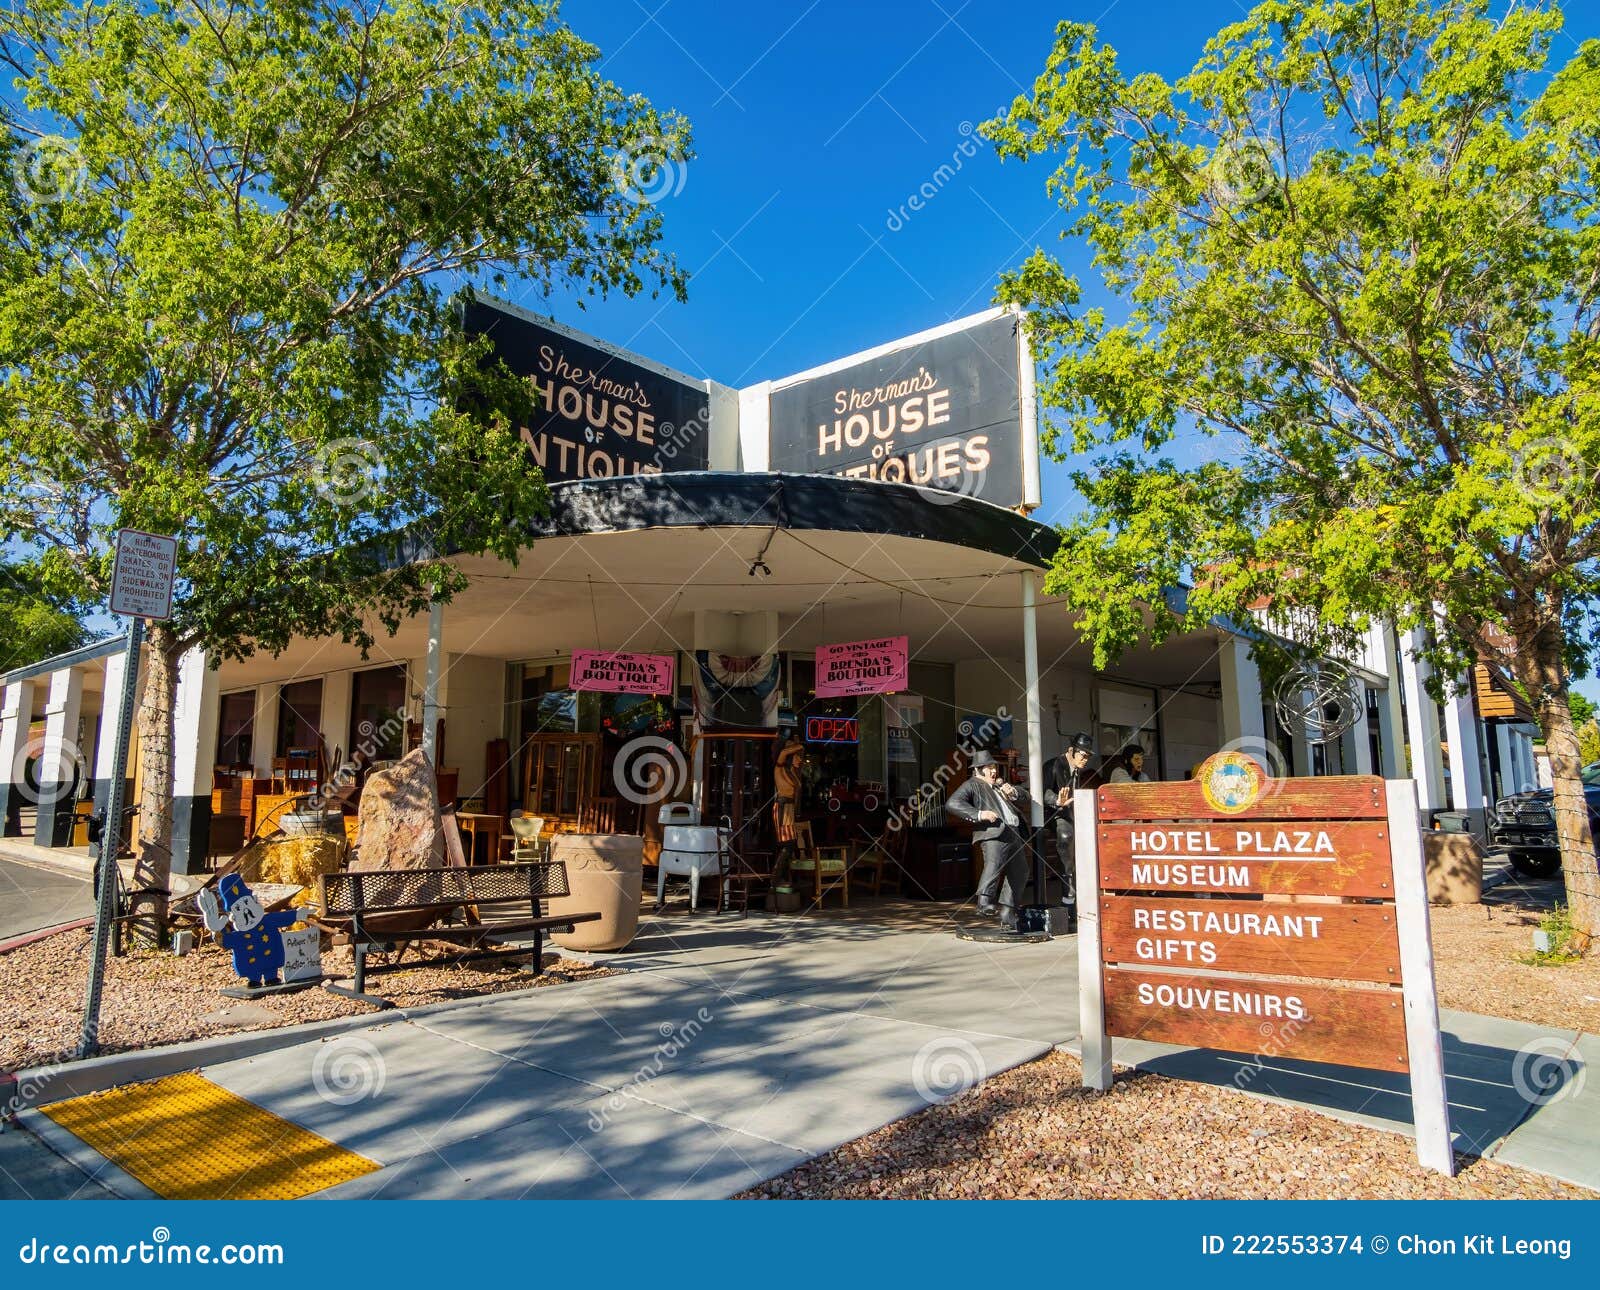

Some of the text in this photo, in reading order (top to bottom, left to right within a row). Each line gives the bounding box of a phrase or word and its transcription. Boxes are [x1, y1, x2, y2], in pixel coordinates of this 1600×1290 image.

[538, 345, 651, 408] Sherman's
[834, 366, 938, 415] Sherman's
[530, 374, 656, 446] HOUSE
[818, 389, 951, 456] HOUSE
[584, 426, 605, 444] OF
[519, 426, 663, 479] NTIQU
[871, 440, 895, 459] OF
[135, 538, 161, 550] RIDING
[120, 565, 169, 581] BICYCLES ON
[158, 562, 168, 571] OR
[119, 585, 165, 600] PROHIBITED
[122, 576, 165, 590] SIDEWALKS
[829, 640, 893, 654] GO VINTAGE!
[590, 659, 657, 673] BRENDA'S
[830, 655, 892, 671] BRENDA'S
[582, 669, 662, 684] BOUTIQUE
[827, 665, 895, 681] BOUTIQUE
[807, 718, 858, 741] OPEN
[1130, 831, 1334, 853] HOTEL PLAZA
[1132, 864, 1250, 887] MUSEUM
[1134, 909, 1323, 938] RESTAURANT
[1135, 937, 1217, 963] GIFTS
[1138, 982, 1304, 1020] SOUVENIRS
